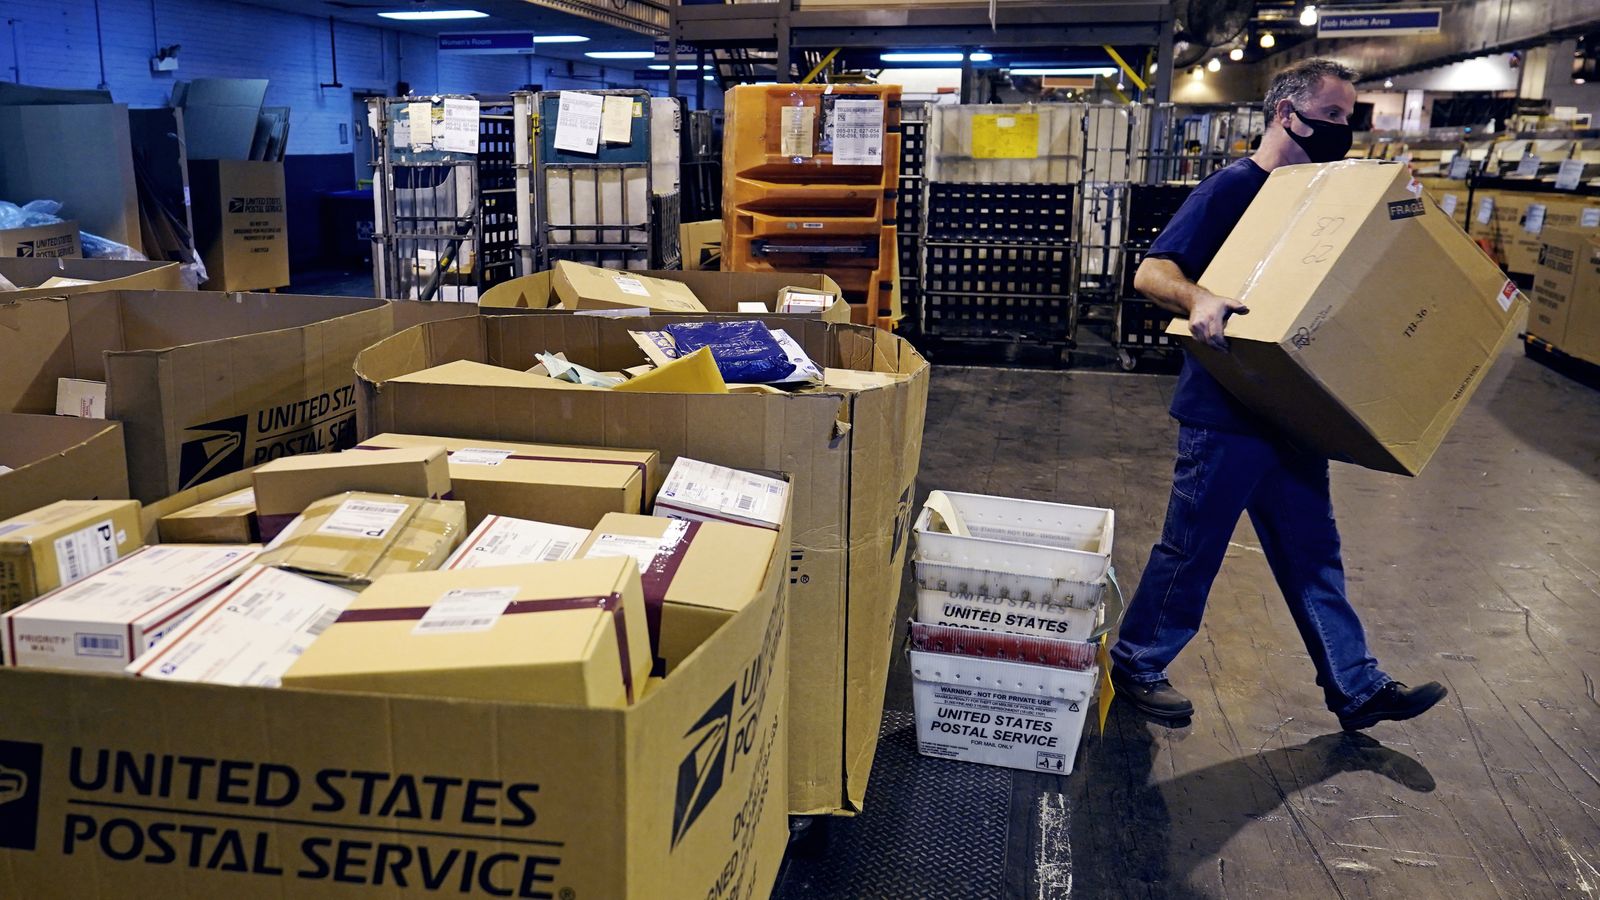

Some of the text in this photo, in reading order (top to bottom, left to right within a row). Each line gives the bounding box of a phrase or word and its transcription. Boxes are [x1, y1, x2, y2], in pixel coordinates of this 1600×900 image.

[1322, 20, 1338, 28] Job
[1340, 18, 1368, 26] Huddle
[256, 392, 330, 434] UNITED
[944, 606, 1001, 623] UNITED
[1005, 614, 1068, 633] STATES
[19, 634, 66, 644] PRIORITY
[941, 686, 972, 696] WARNING
[1008, 696, 1036, 704] PRIVATE
[938, 707, 1053, 732] UNITED STATES
[930, 721, 1058, 748] POSTAL SERVICE
[69, 747, 540, 827] UNITED STATES
[63, 814, 560, 900] POSTAL SERVICE
